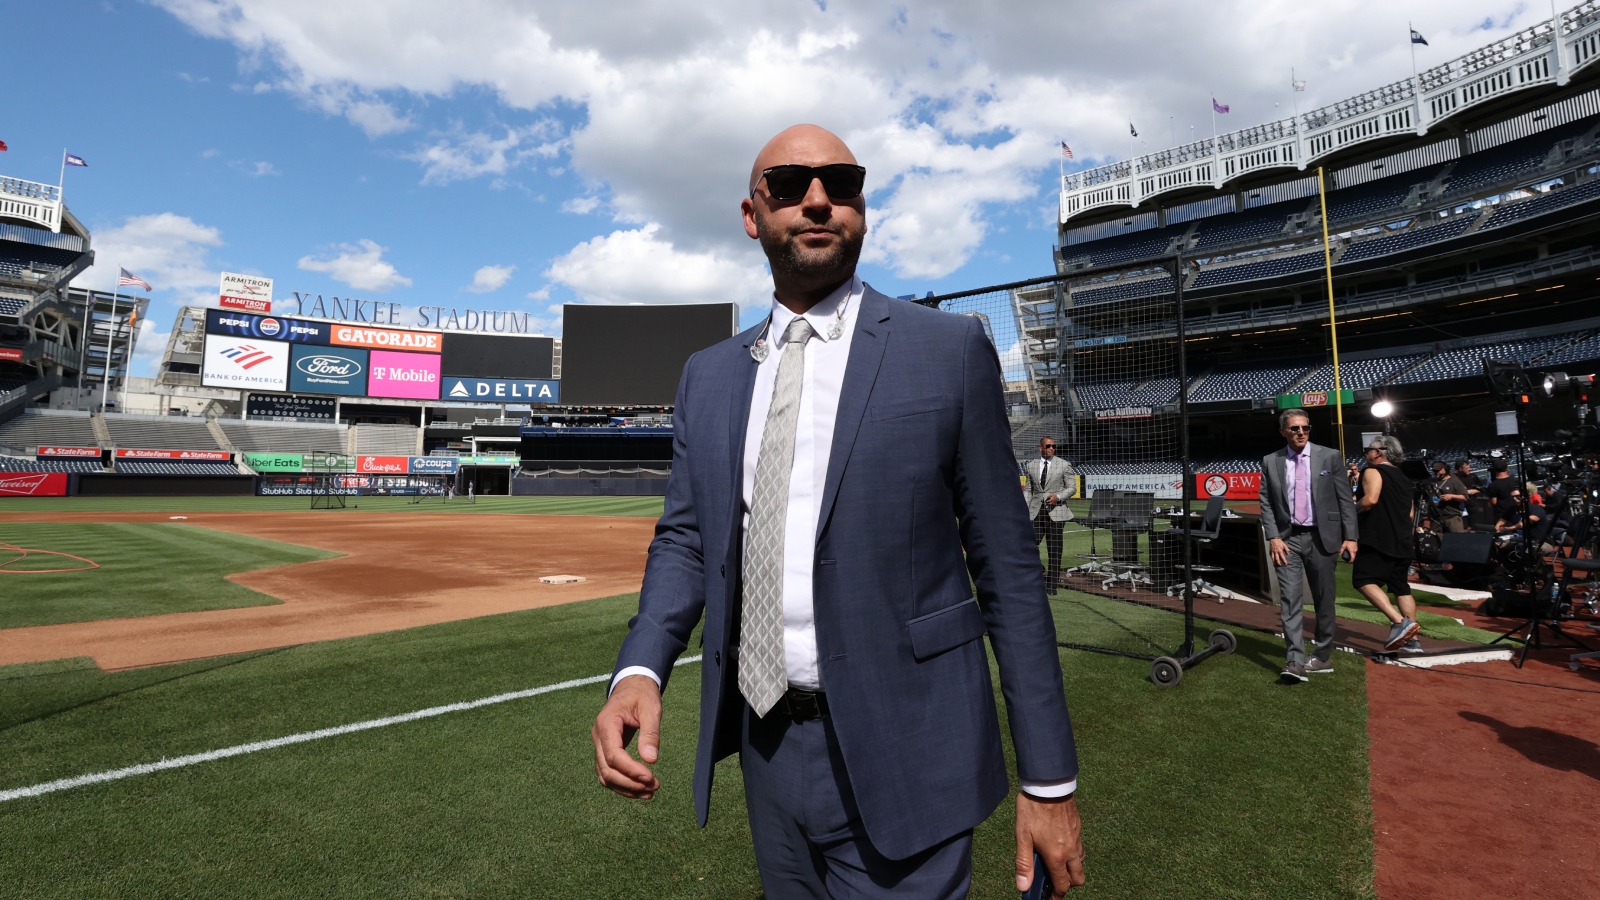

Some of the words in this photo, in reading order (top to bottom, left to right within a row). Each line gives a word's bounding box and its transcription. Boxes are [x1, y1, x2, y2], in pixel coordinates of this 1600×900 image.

[224, 276, 270, 288] ARMITRON
[224, 297, 267, 308] ARMITRON
[291, 291, 401, 325] YANKEE
[417, 306, 531, 334] STADIUM
[219, 318, 249, 328] PEPSI
[291, 326, 319, 335] PEPSI
[337, 328, 437, 348] GATORADE
[307, 357, 351, 375] Ford
[245, 376, 284, 384] AMERICA
[389, 367, 436, 383] Mobile
[306, 377, 350, 385] BuyFordNow.com
[476, 382, 552, 398] DELTA
[1095, 409, 1115, 417] Parts
[1115, 405, 1152, 416] Authority
[76, 448, 96, 456] Farm
[274, 458, 300, 467] Eats
[425, 460, 452, 469] coupa
[1229, 476, 1255, 488] F.W.
[261, 487, 293, 495] StubHub
